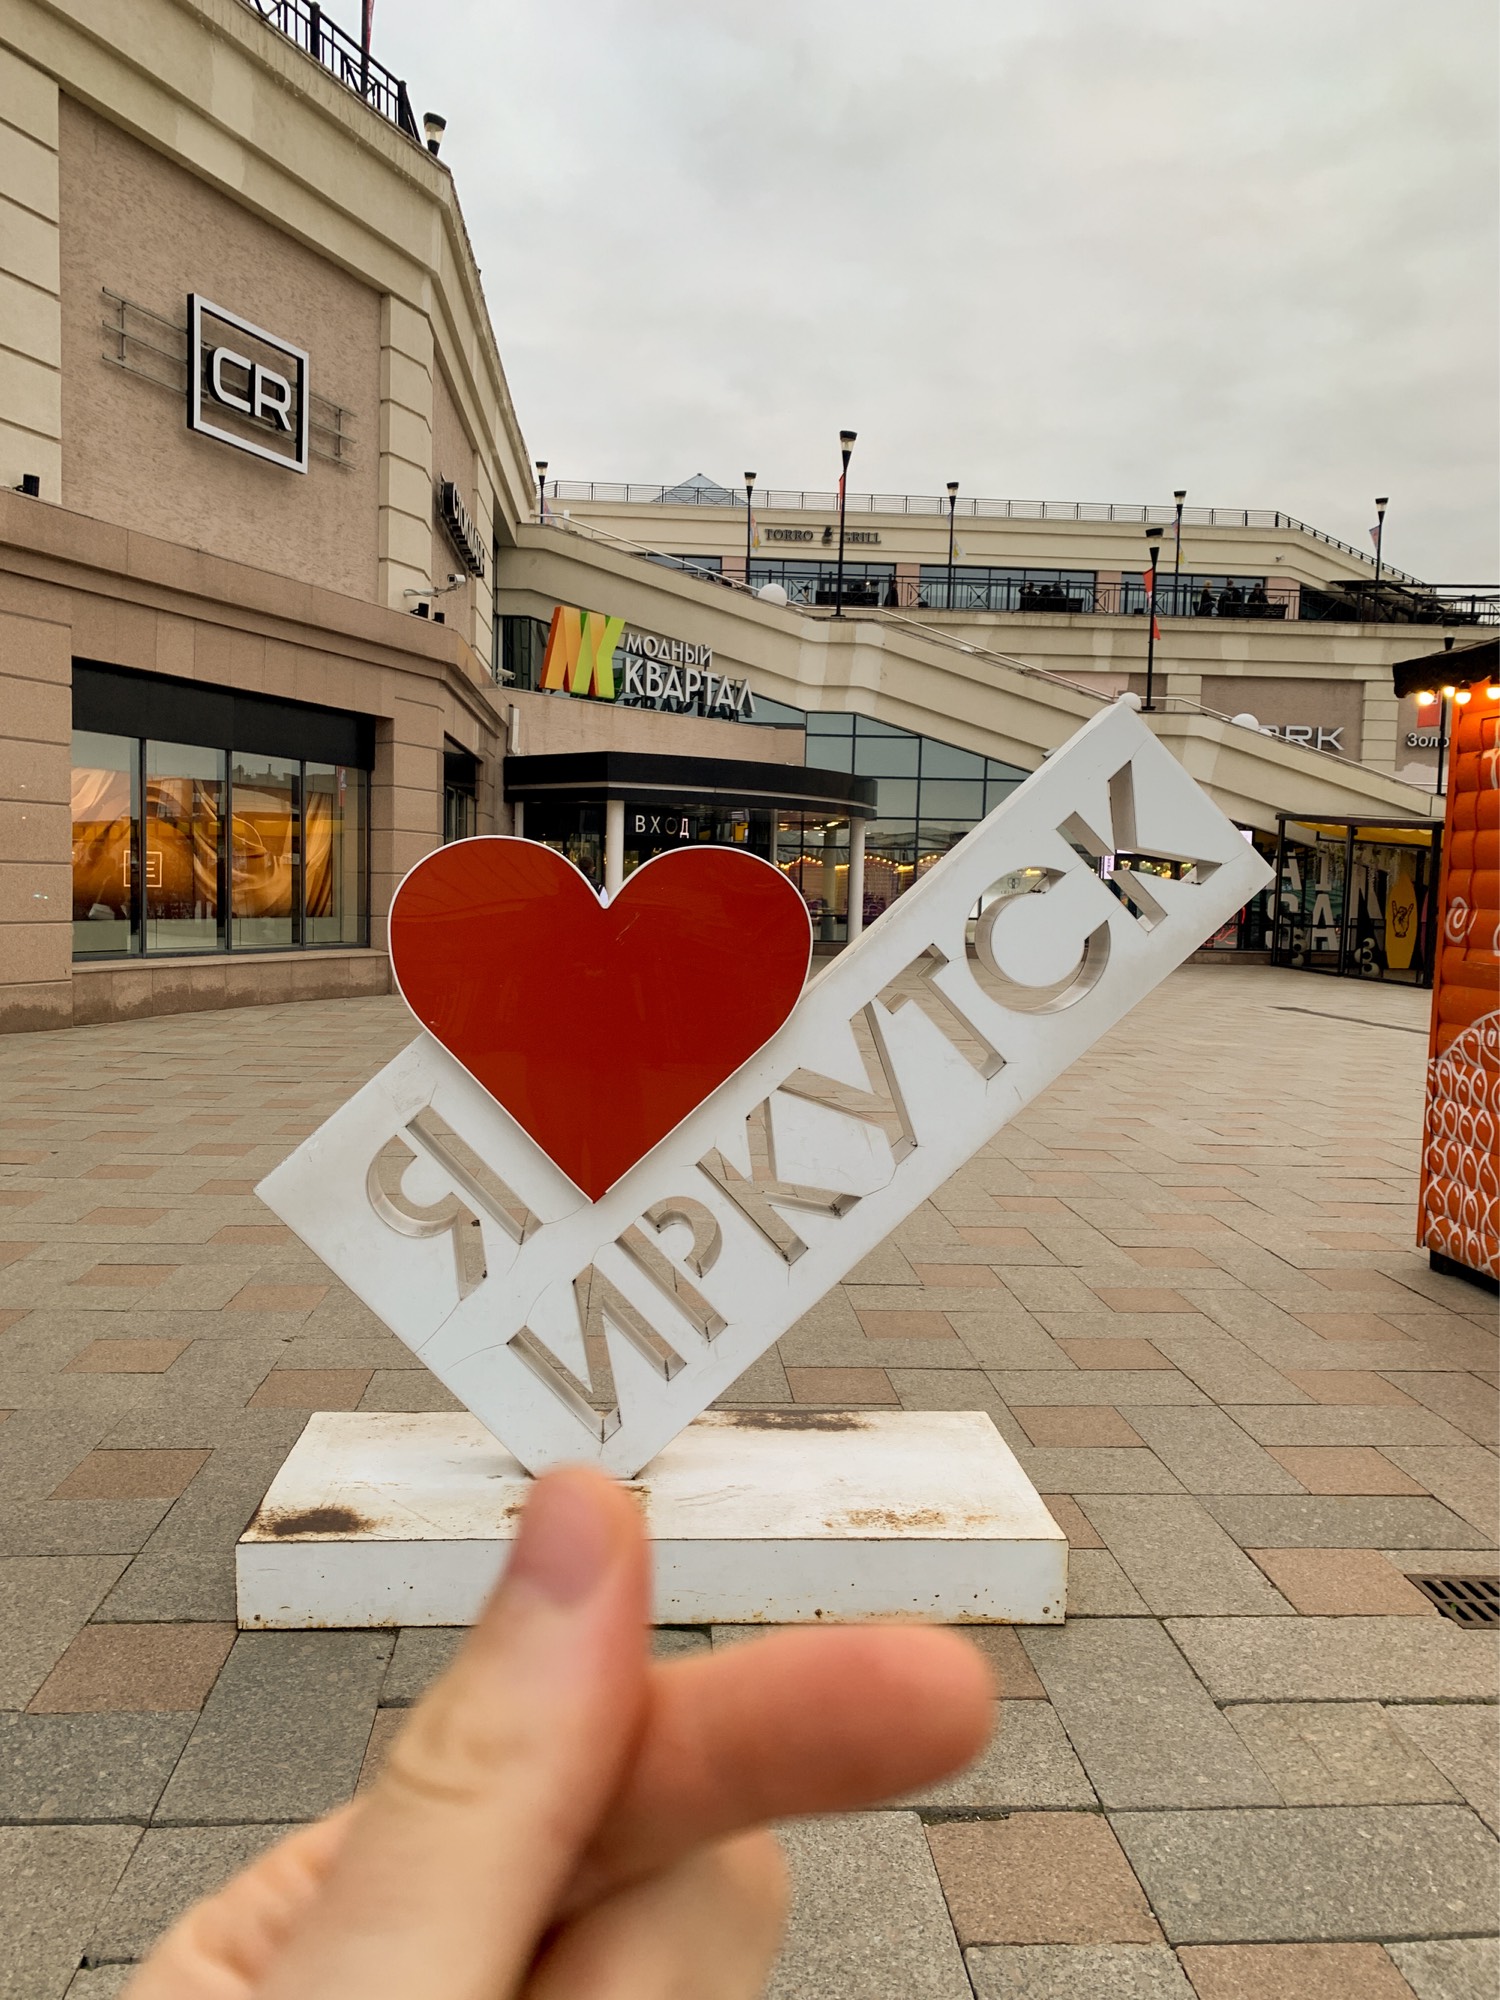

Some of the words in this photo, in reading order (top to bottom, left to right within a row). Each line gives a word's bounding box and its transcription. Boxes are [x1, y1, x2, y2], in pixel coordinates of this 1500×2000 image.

[208, 346, 292, 432] CR
[765, 528, 814, 541] TORRO
[625, 632, 713, 667] МОДНЫЙ
[623, 657, 756, 713] КВАРТАЛ
[635, 815, 689, 839] ВХОД
[507, 760, 1222, 1444] ИРКУТСК
[365, 1106, 543, 1301] Я
